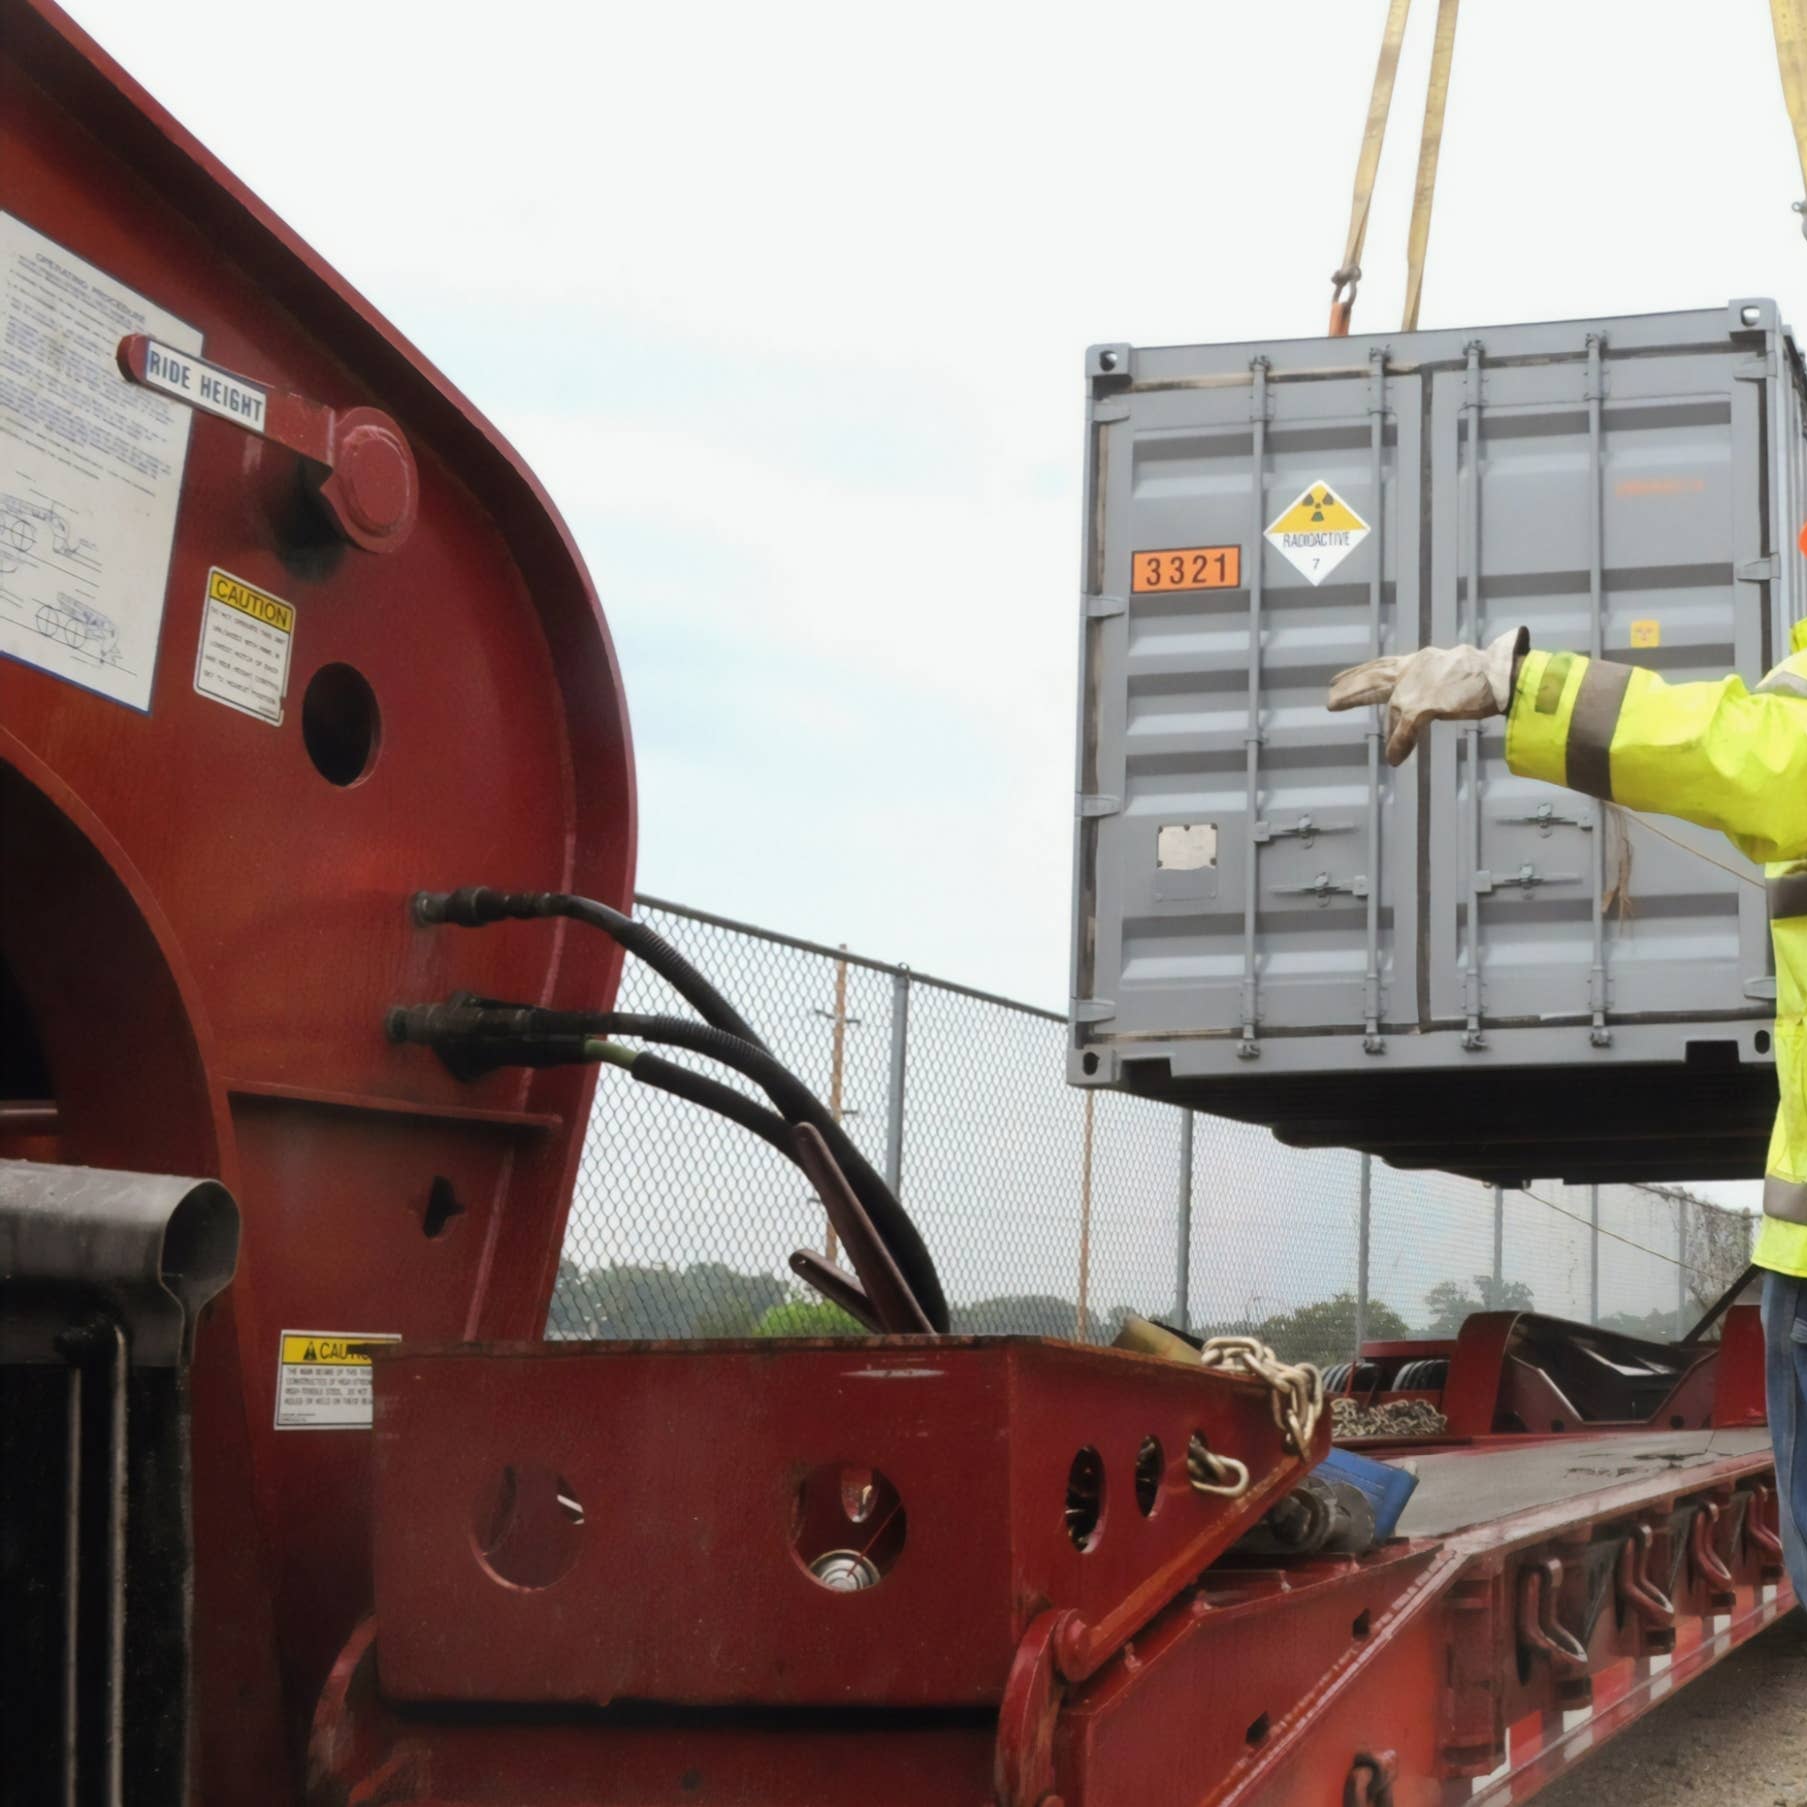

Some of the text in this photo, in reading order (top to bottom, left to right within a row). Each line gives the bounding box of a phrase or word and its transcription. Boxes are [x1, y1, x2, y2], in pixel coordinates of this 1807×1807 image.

[149, 350, 263, 423] RIDE HEIGHT
[1283, 531, 1351, 549] RADIOACTIVE
[1145, 553, 1226, 586] 3321
[1312, 557, 1321, 570] 7
[215, 579, 289, 627] CAUTION
